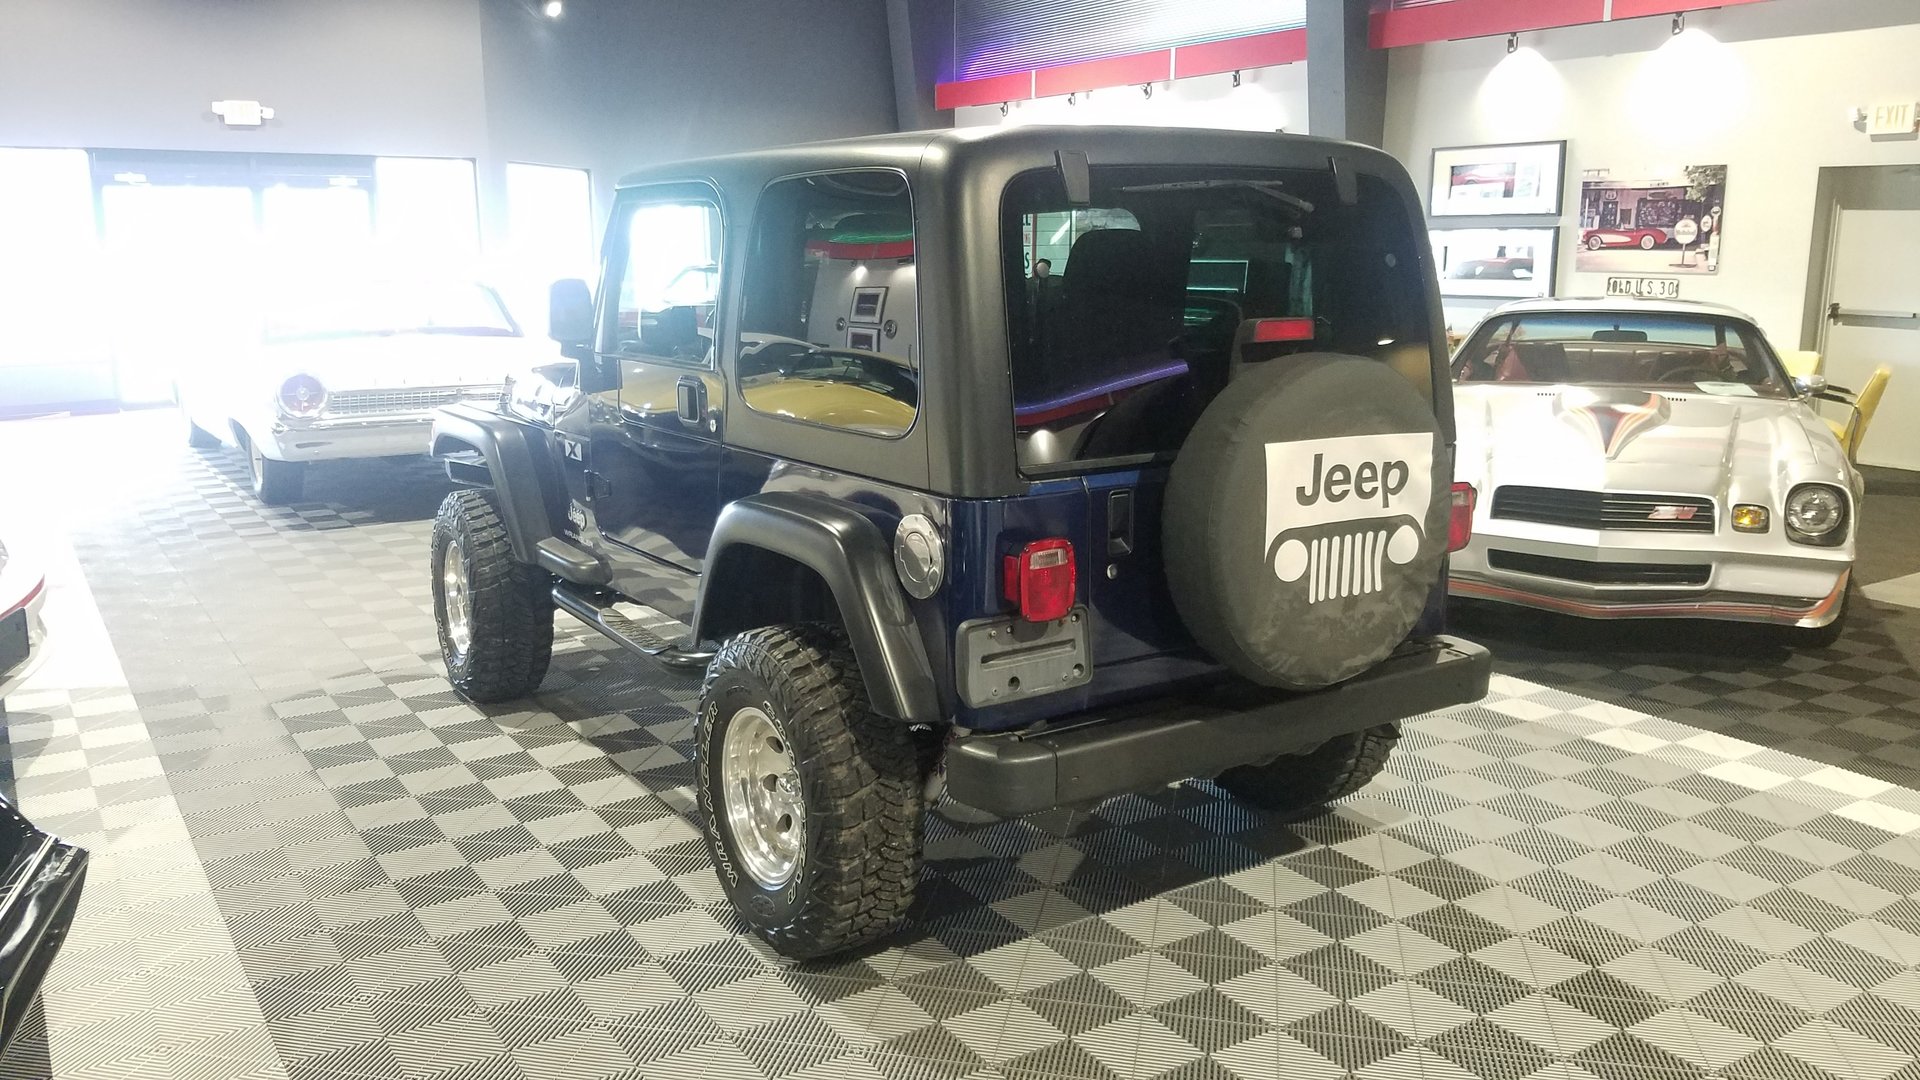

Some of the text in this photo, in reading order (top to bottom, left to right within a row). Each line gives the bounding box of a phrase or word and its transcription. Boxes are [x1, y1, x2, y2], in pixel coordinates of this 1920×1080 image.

[1875, 104, 1909, 129] EXIT
[1660, 281, 1674, 296] 30
[1296, 453, 1410, 509] Jeep
[568, 502, 587, 532] Jeep
[701, 700, 739, 888] WRANGLER
